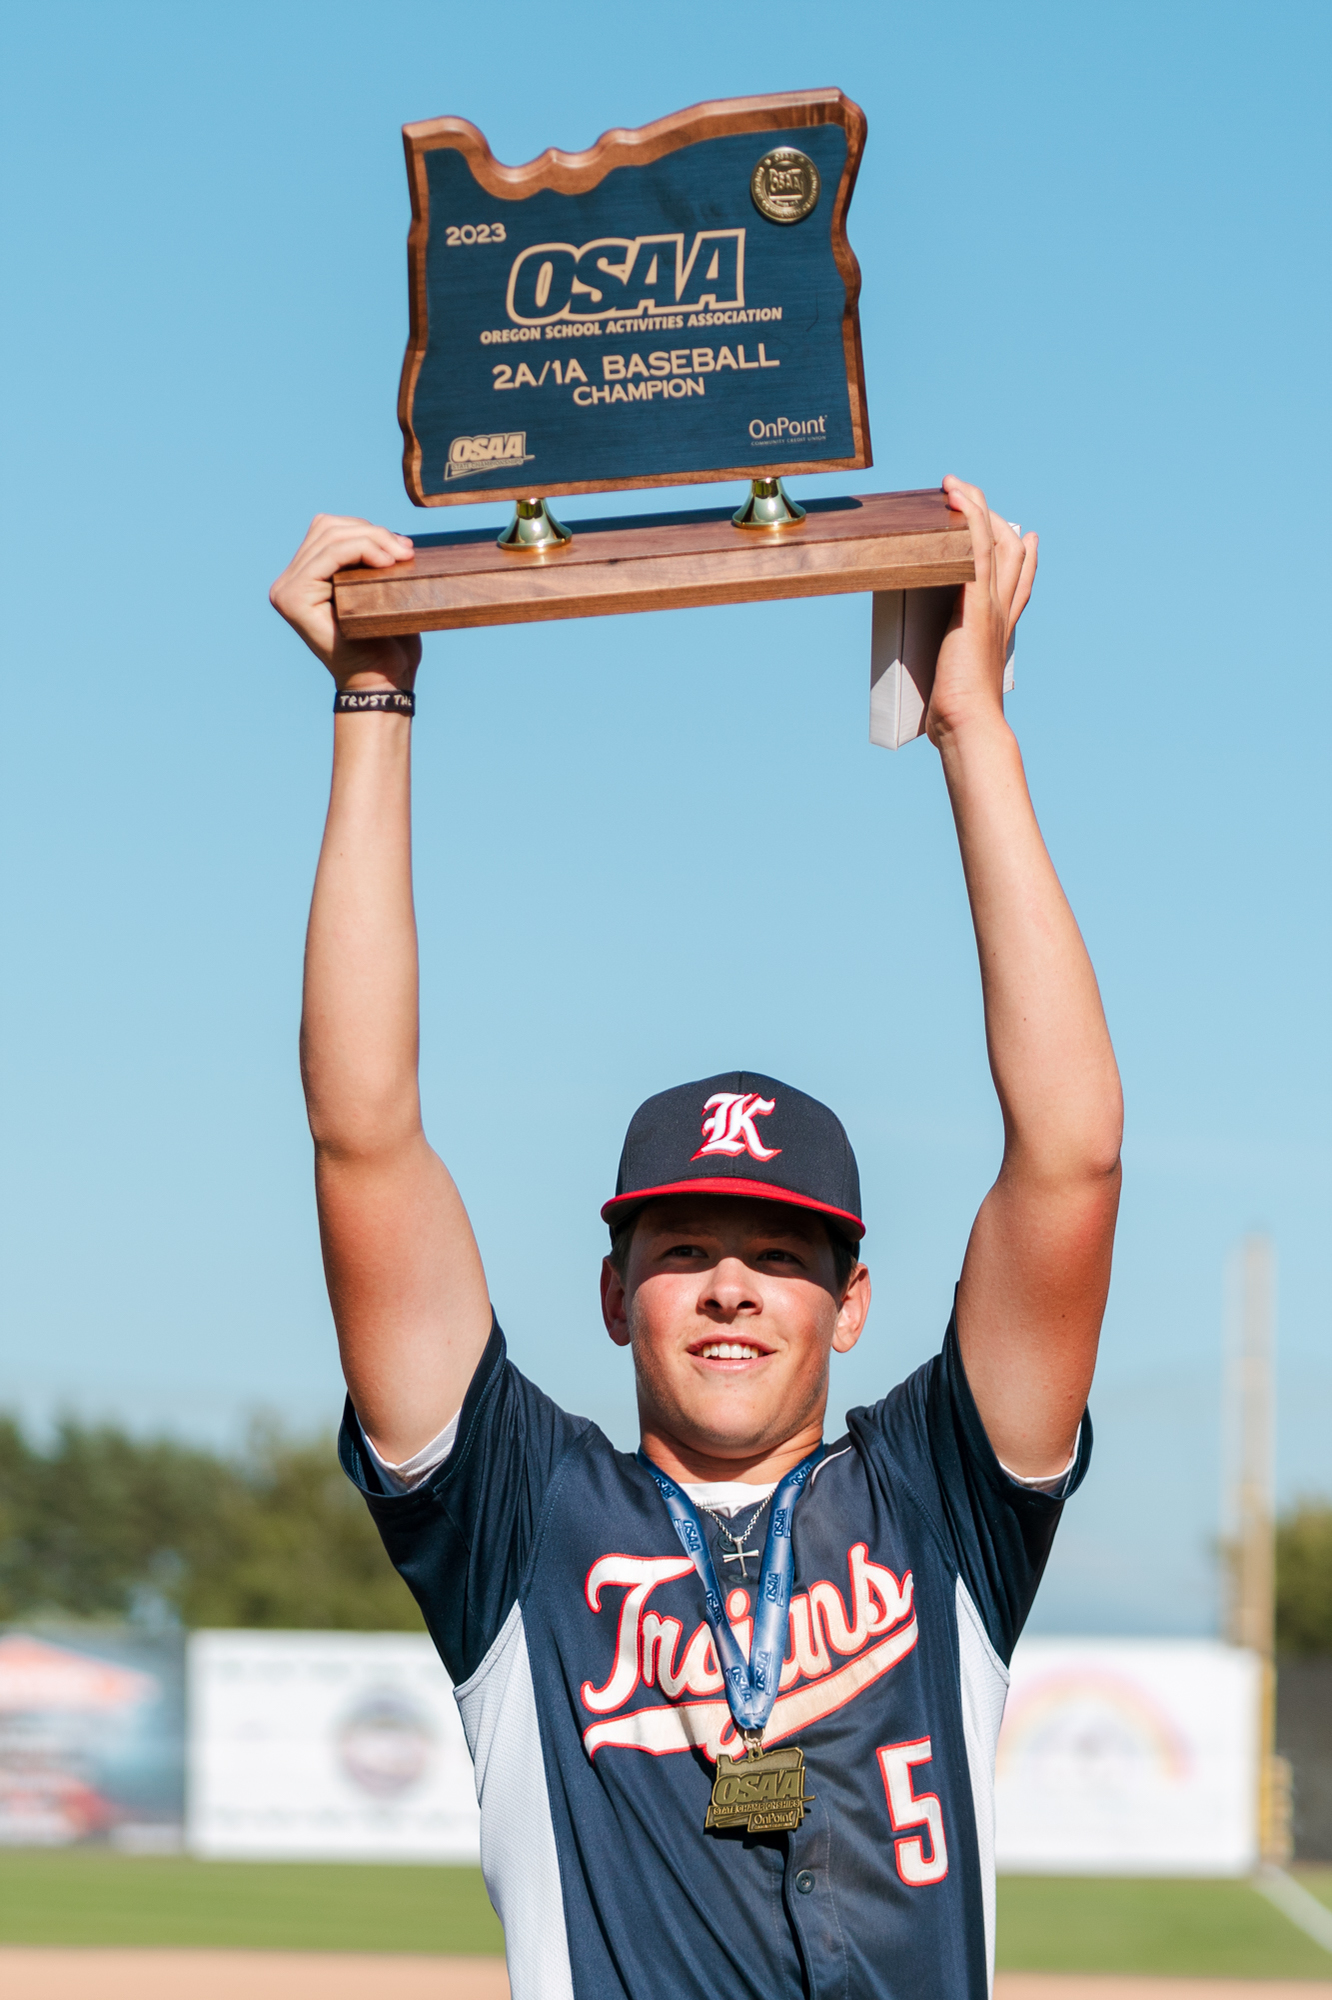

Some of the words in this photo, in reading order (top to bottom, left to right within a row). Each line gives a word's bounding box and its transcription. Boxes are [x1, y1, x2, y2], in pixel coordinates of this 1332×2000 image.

[445, 222, 507, 247] 2023
[506, 228, 746, 326] OSAA
[480, 326, 541, 345] OREGON
[545, 322, 602, 339] SCHOOL
[605, 314, 684, 334] ACTIVITIES
[687, 306, 783, 328] ASSOCIATION
[491, 358, 588, 390] 2A/1A
[602, 342, 780, 381] BASEBALL
[572, 376, 705, 406] CHAMPION
[748, 415, 827, 439] OnPoint
[449, 431, 526, 463] OSAA
[340, 694, 391, 707] TRUST
[690, 1092, 783, 1162] K
[654, 1476, 679, 1500] OSAA
[683, 1519, 701, 1552] OSAA
[773, 1508, 787, 1537] OSAA
[766, 1572, 779, 1602] OSAA
[755, 1650, 770, 1691] OSAA
[712, 1769, 802, 1807] OSAA
[713, 1804, 736, 1815] STATE
[737, 1799, 801, 1813] CHAMPIONSHIPS
[753, 1810, 794, 1826] OnPoint
[875, 1735, 948, 1887] 5
